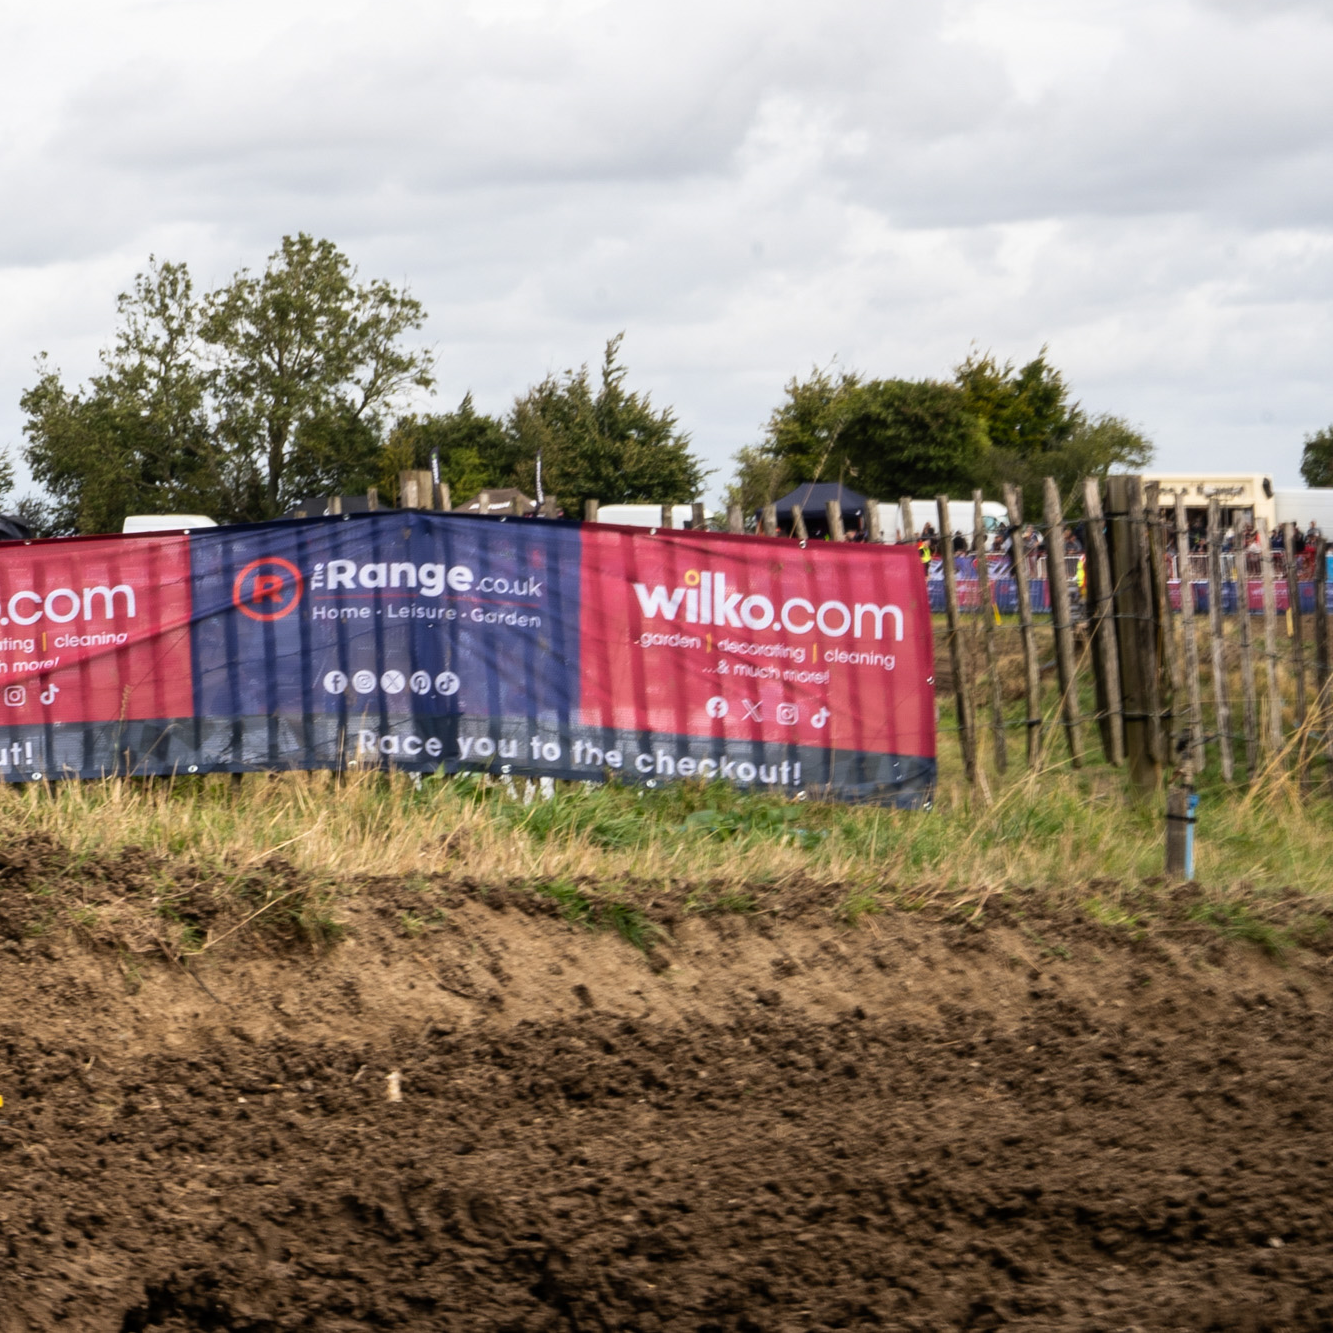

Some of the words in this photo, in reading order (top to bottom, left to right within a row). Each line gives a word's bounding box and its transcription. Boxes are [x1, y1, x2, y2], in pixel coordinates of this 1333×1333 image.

[327, 559, 542, 597] Range.co.uk
[312, 605, 371, 620] Home
[387, 602, 457, 621] Leisure
[471, 607, 541, 628] Garden
[633, 569, 904, 641] wilko.com
[54, 631, 128, 648] cleaning
[639, 632, 701, 650] garden
[717, 638, 806, 663] decorating
[824, 648, 896, 671] cleaning
[12, 656, 60, 673] more!
[733, 662, 780, 681] much
[784, 668, 829, 684] more!
[359, 729, 443, 757] Race
[456, 736, 518, 761] you
[530, 736, 562, 762] to
[572, 740, 624, 767] the
[635, 749, 802, 786] checkout!
